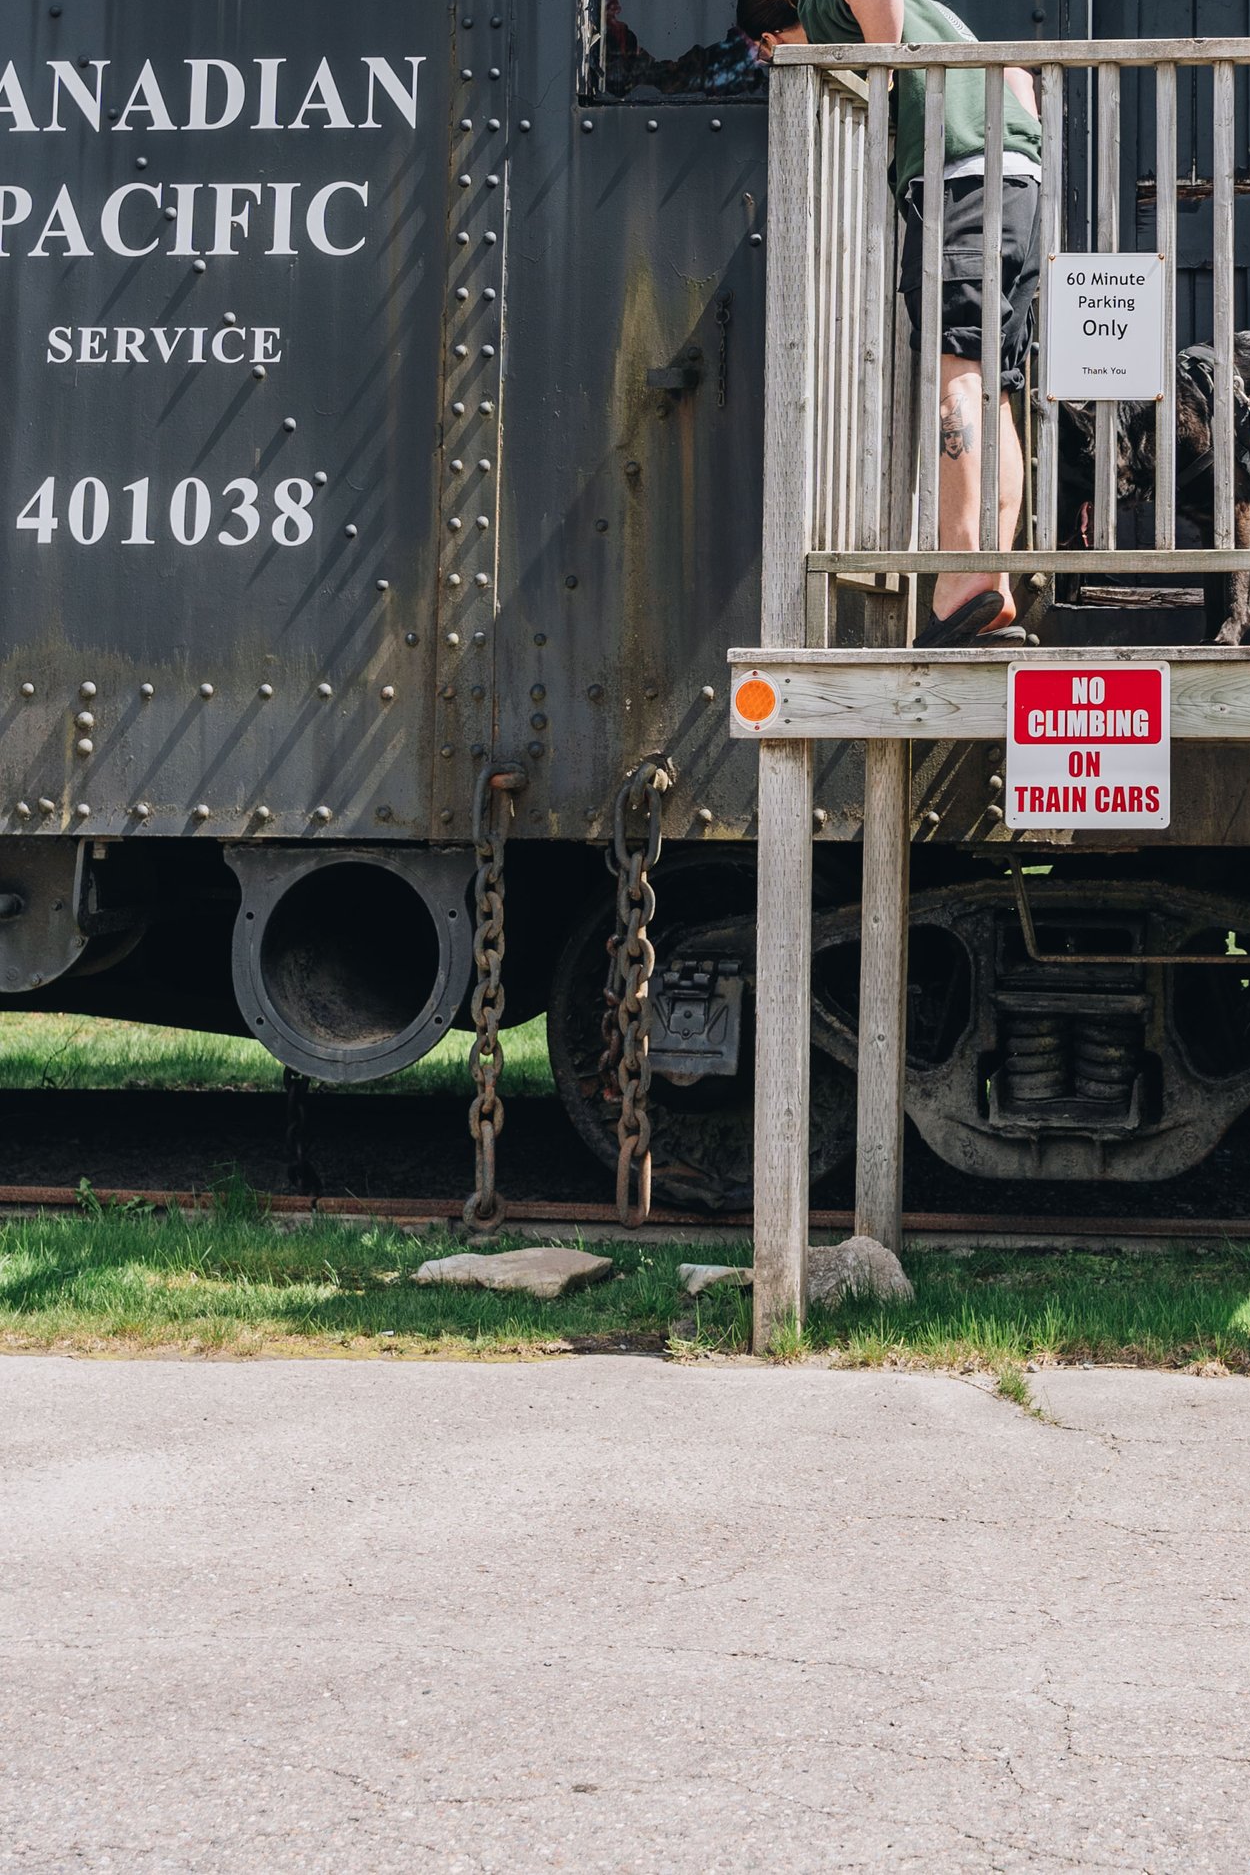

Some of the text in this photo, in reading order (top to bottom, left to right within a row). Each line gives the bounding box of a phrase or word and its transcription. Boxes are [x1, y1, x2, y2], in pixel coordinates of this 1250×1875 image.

[0, 56, 427, 132] ANADIAN
[0, 181, 369, 257] PACIFIC
[1066, 272, 1146, 286] 60 Minute
[1078, 295, 1135, 312] Parking
[1082, 319, 1129, 340] Only
[46, 327, 282, 364] SERVICE
[1082, 366, 1127, 375] Thank You
[16, 476, 315, 546] 401038
[1072, 676, 1105, 705] NO
[1027, 709, 1149, 738] CLIMBING
[1068, 750, 1101, 778] ON
[1014, 785, 1160, 813] TRAIN CARS
